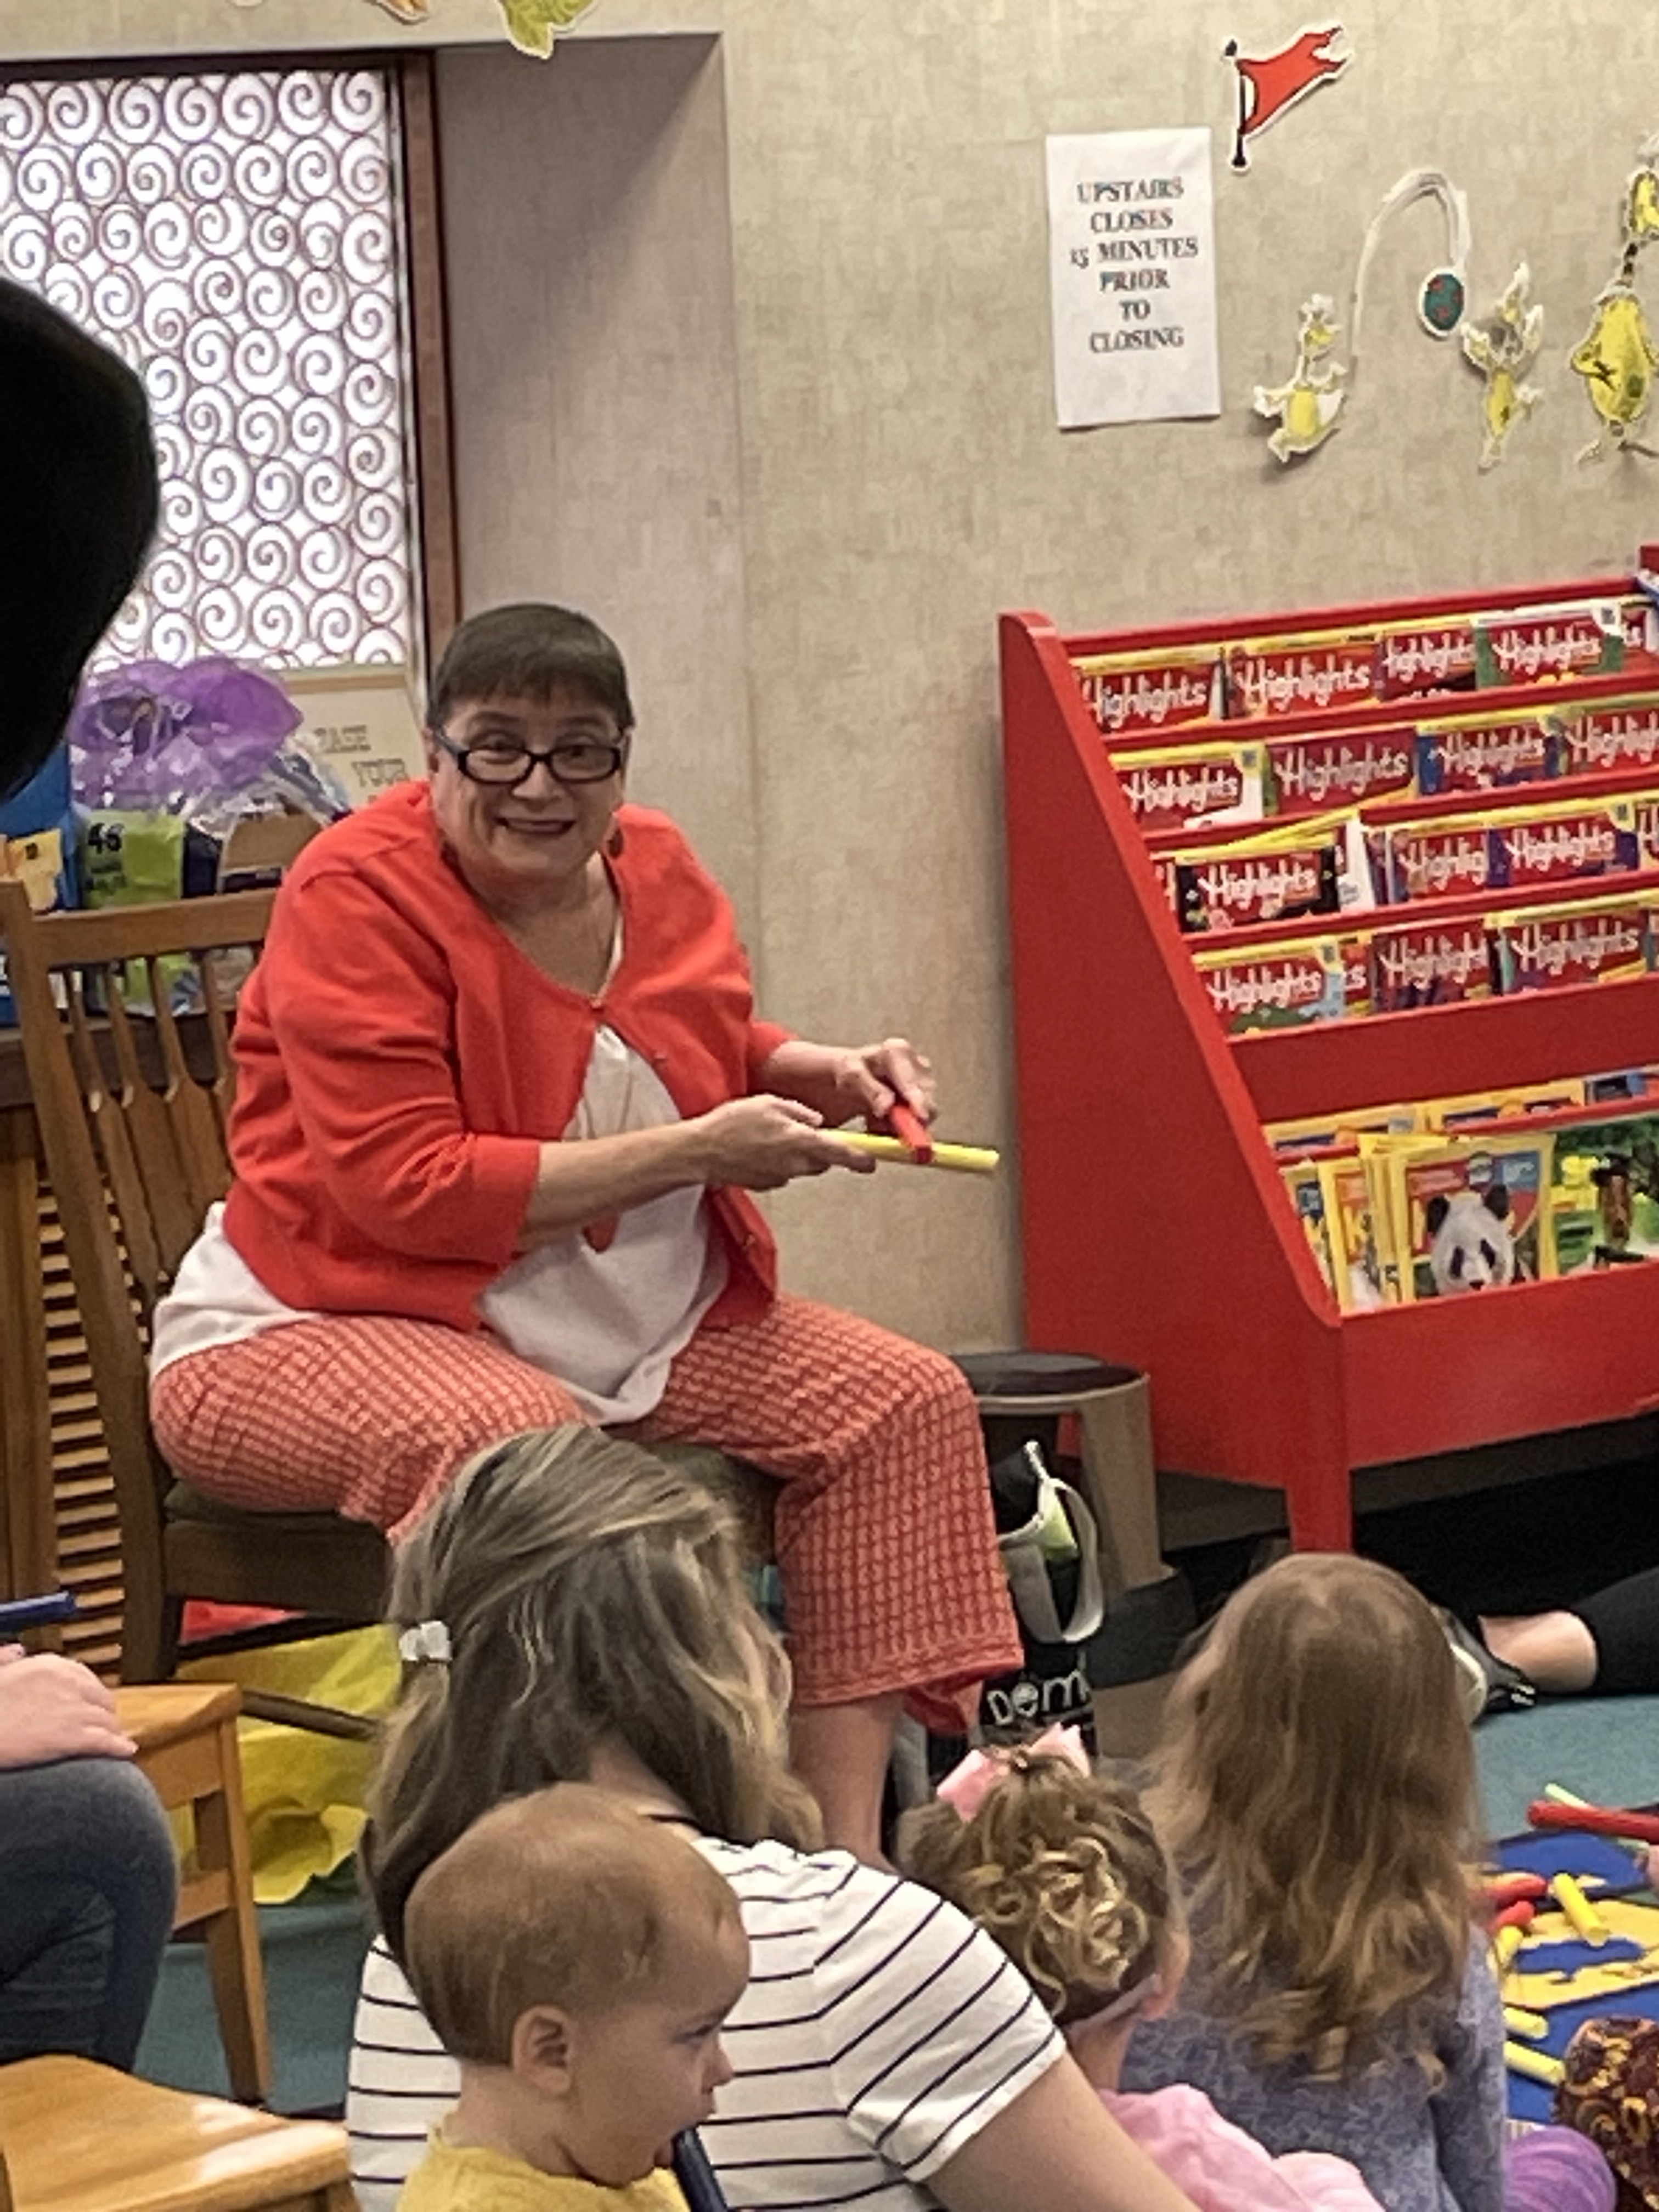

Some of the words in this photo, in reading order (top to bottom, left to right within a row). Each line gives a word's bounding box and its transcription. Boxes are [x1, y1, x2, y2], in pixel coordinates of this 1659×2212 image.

[1077, 177, 1184, 203] UPSTAIRS
[1090, 208, 1173, 233] CLOSES
[1097, 236, 1198, 261] MINUTES
[1099, 269, 1170, 292] PRIOR
[1119, 299, 1151, 321] TO
[1089, 328, 1184, 354] CLOSING
[1492, 626, 1601, 675] Highlights
[1235, 654, 1370, 713] Highlights
[1274, 741, 1409, 802] Highlights
[1436, 726, 1545, 778] Highlights
[1122, 767, 1238, 813] Highlights
[1505, 822, 1616, 871] Highlights
[1197, 859, 1317, 911] Highlights
[1510, 917, 1639, 975] Highlights
[1206, 963, 1321, 1014] Highlights
